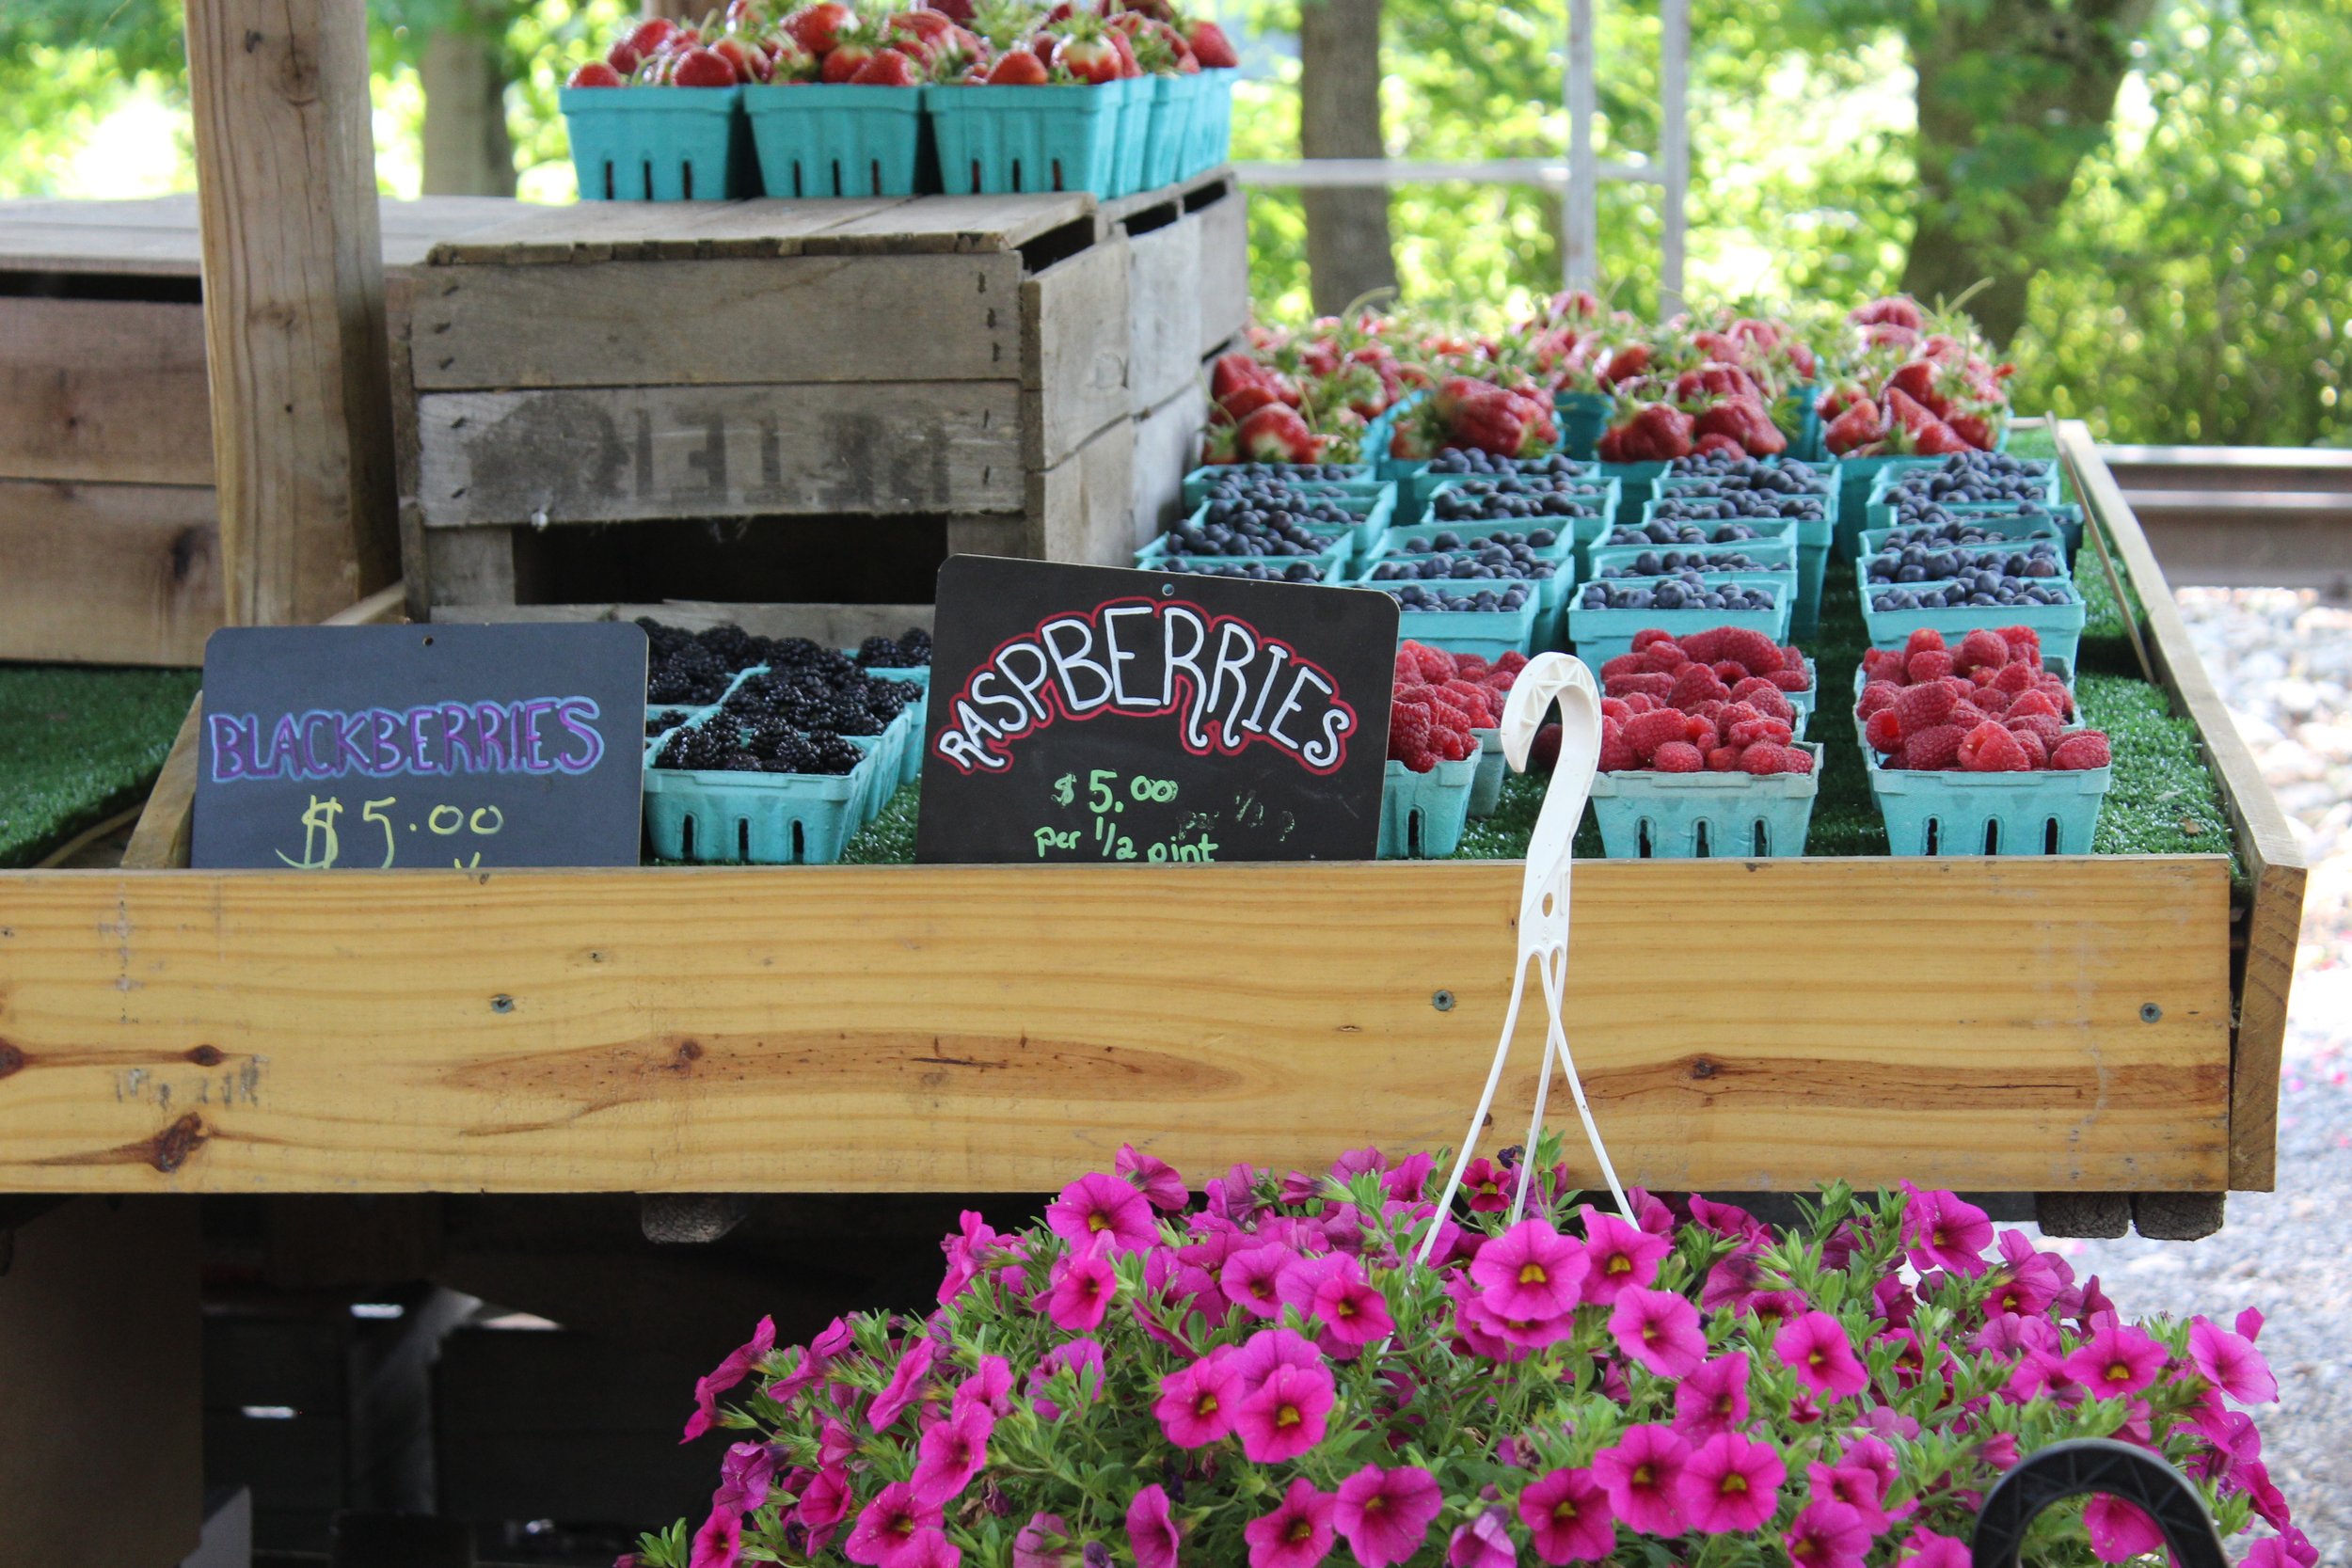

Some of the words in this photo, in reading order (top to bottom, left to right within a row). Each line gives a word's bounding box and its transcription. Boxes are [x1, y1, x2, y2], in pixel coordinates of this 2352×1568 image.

[933, 595, 1358, 775] RASPBERRIES
[209, 695, 605, 783] BLACKBERRIES
[1034, 827, 1082, 858] per
[1095, 816, 1138, 861] 1/2
